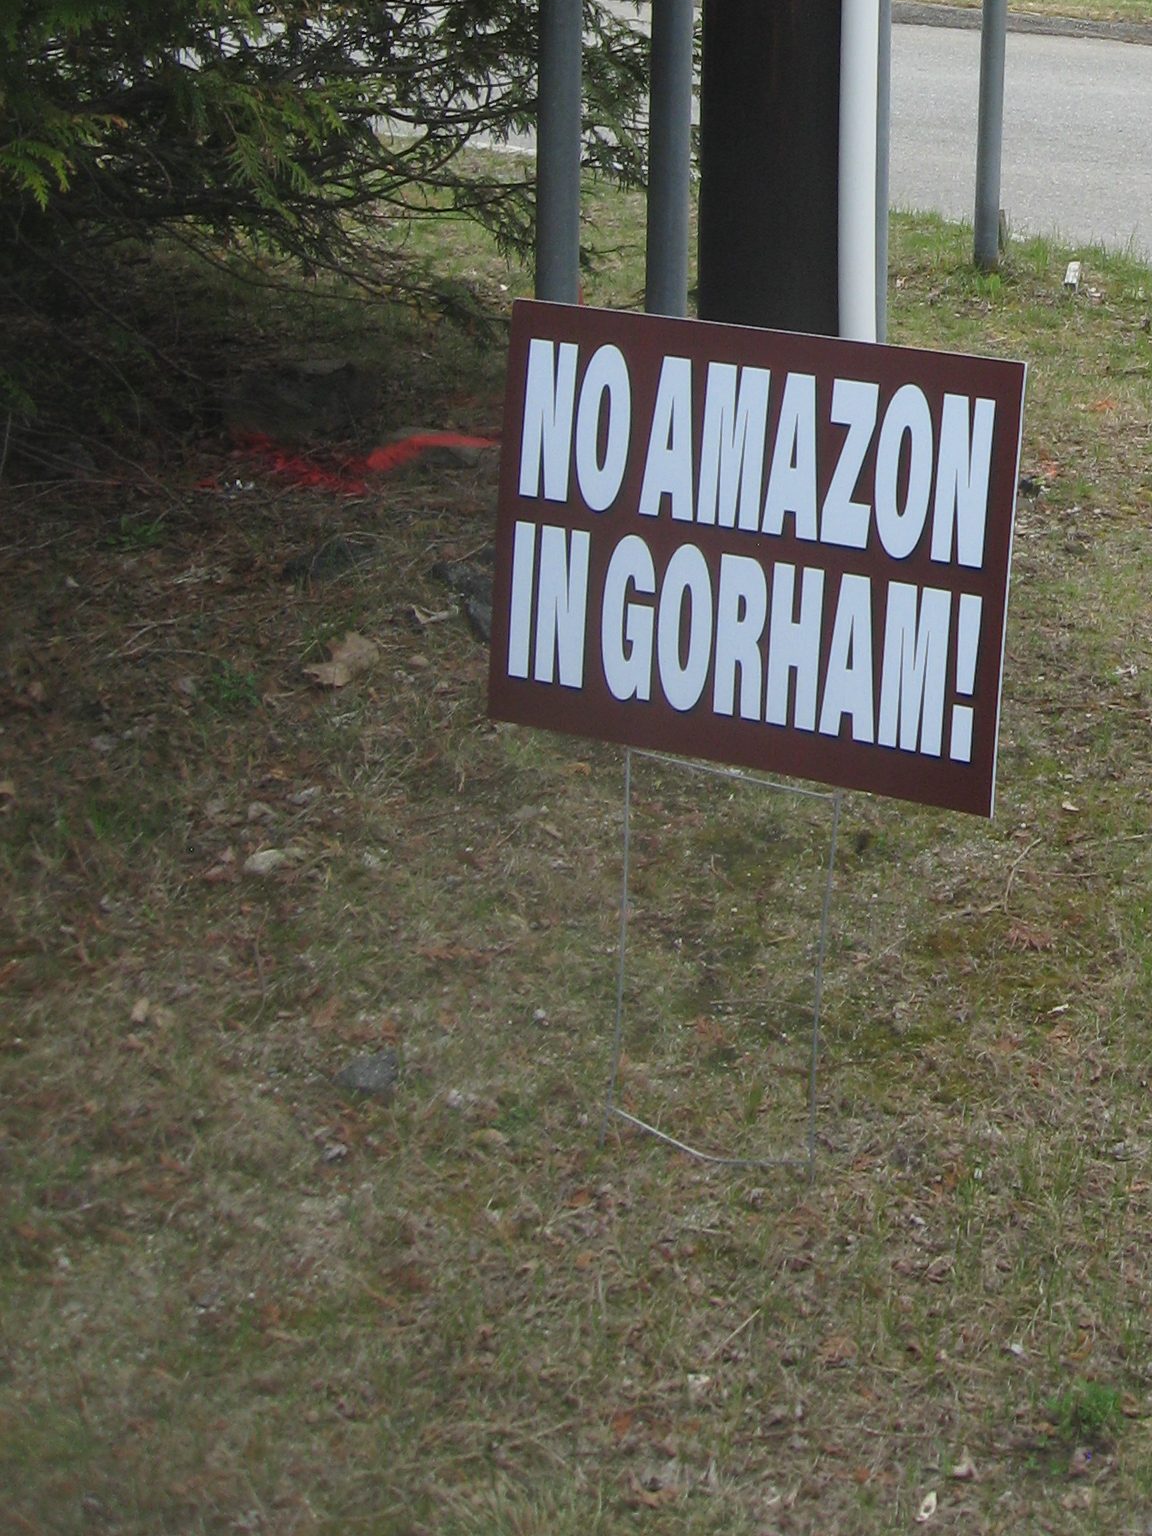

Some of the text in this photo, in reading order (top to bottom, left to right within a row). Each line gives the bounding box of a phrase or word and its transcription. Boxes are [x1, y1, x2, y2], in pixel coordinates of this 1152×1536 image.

[518, 338, 997, 569] NO AMAZON
[507, 520, 983, 763] IN GORHAM!
